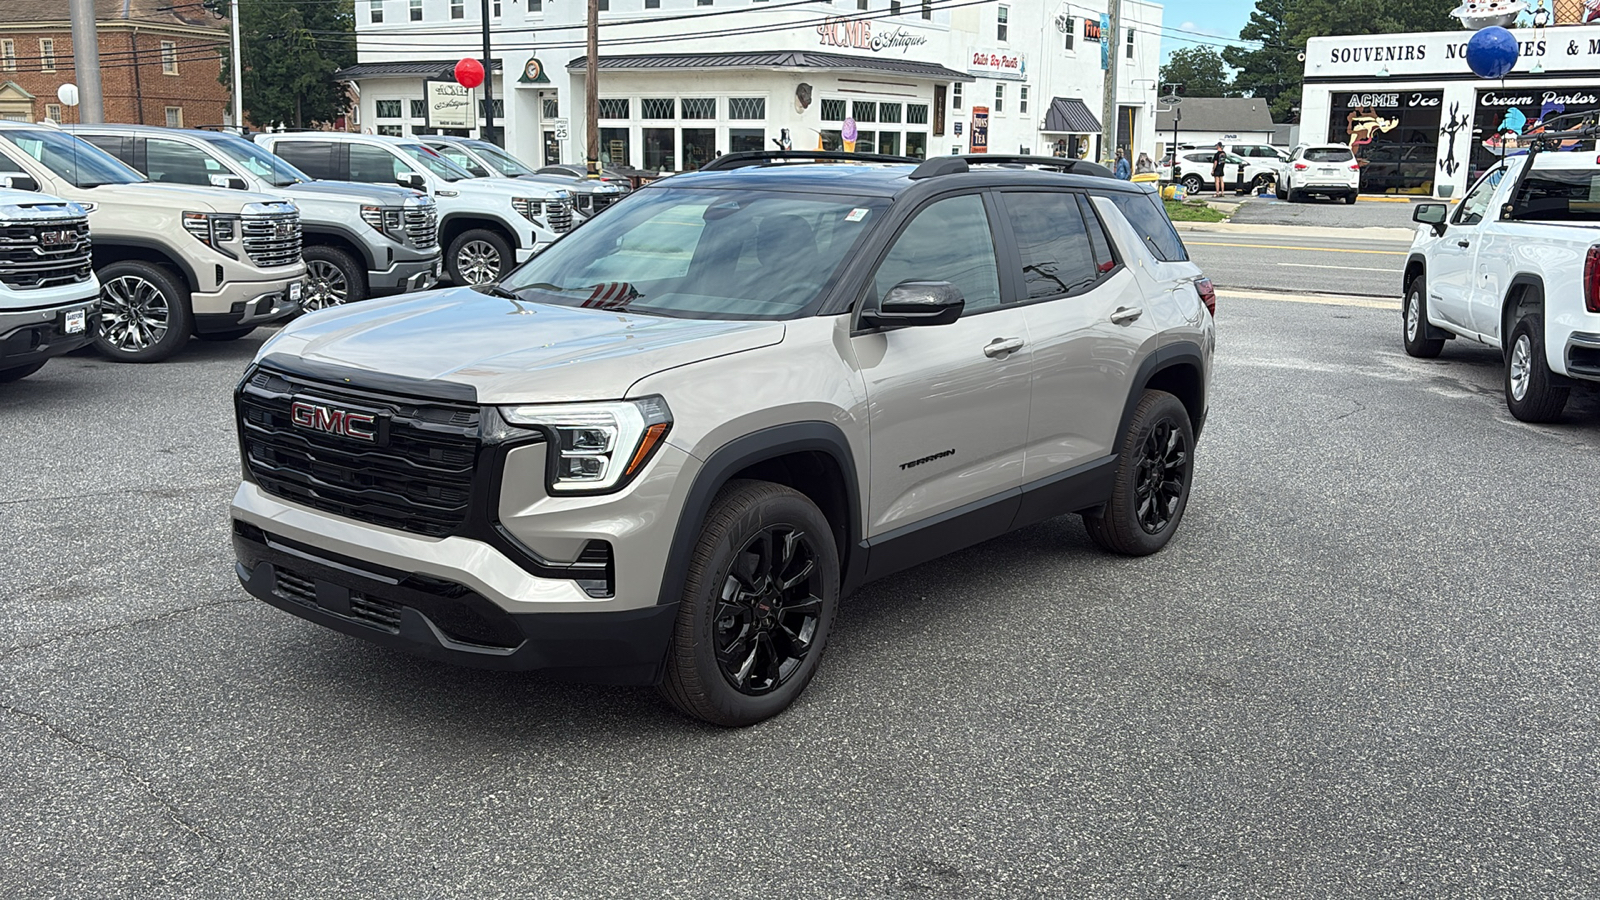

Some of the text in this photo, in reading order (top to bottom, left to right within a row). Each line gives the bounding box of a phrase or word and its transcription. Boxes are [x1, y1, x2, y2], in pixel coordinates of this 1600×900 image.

[816, 15, 871, 50] ACME
[883, 26, 927, 54] Antiques
[1331, 45, 1426, 63] SOUVENIRS
[1445, 40, 1546, 59] NOIES
[1567, 39, 1579, 56] &
[973, 52, 1018, 70] Dutch Boy Paints
[1347, 91, 1598, 107] ACME Ice Cream Parlor
[556, 129, 568, 138] 25
[975, 132, 985, 144] TEA
[41, 230, 78, 246] GMC
[291, 401, 375, 441] GMC
[899, 448, 955, 471] TERRAIN
